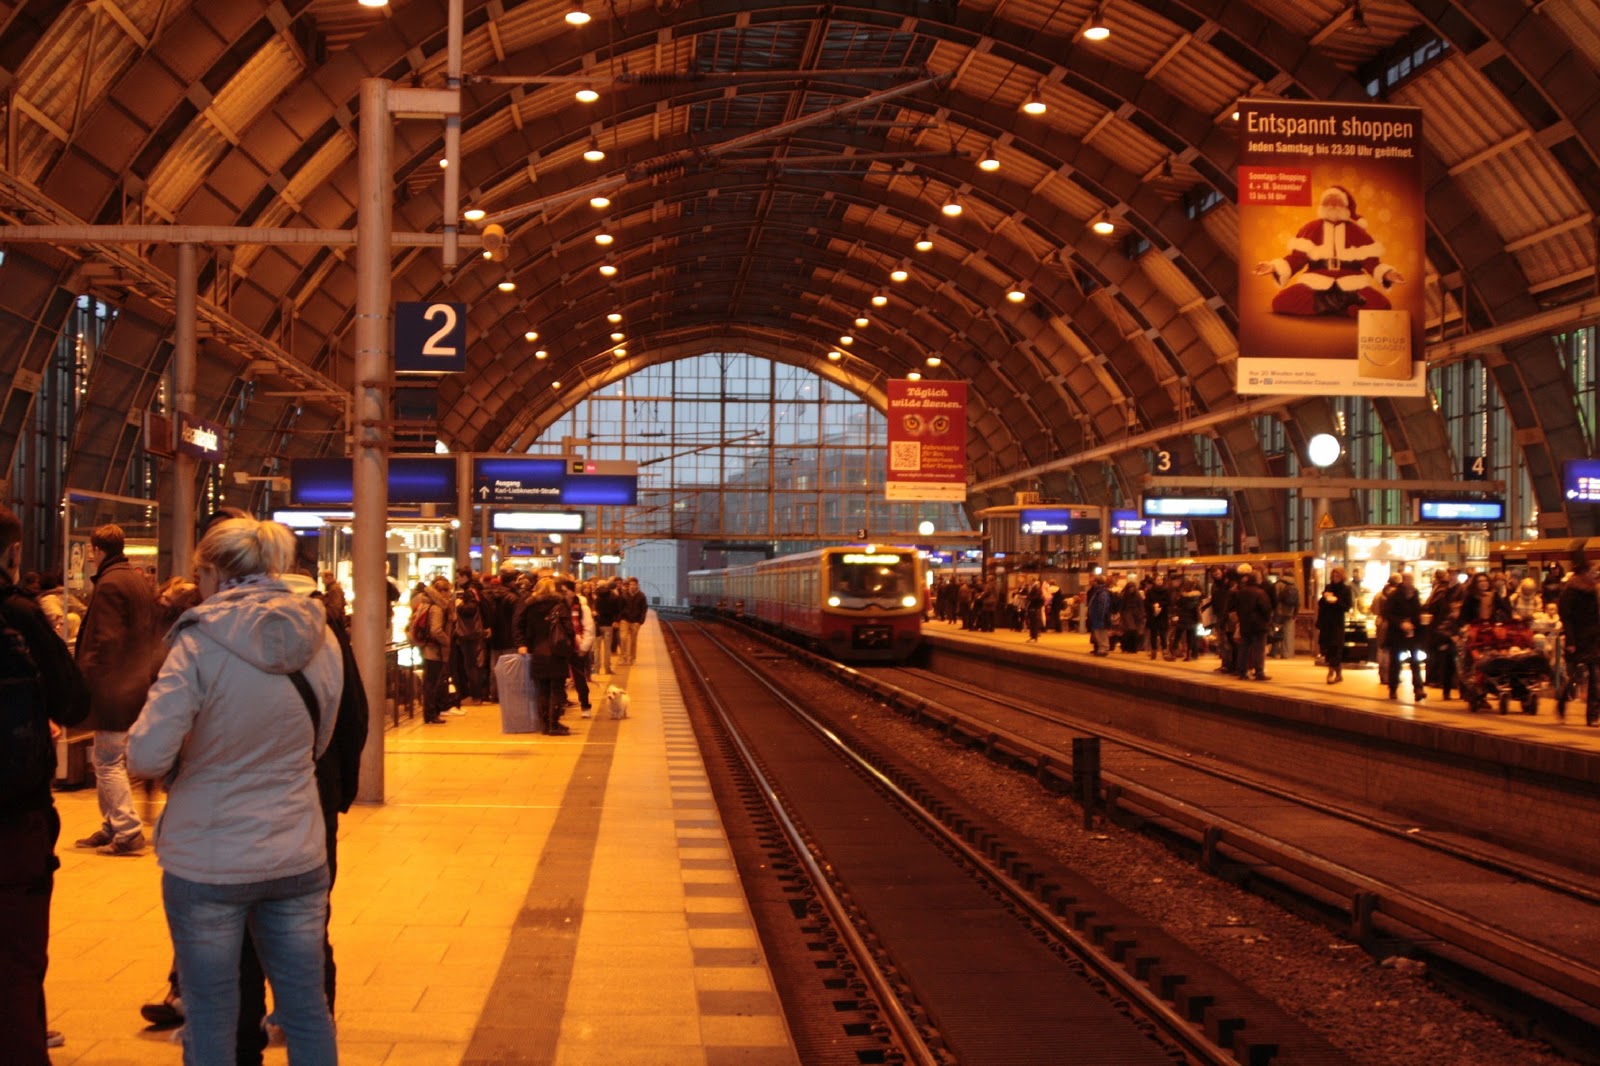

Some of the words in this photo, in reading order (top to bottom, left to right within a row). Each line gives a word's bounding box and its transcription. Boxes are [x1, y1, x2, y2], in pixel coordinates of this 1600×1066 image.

[1248, 111, 1337, 137] Entspannt
[1342, 116, 1413, 141] shoppen
[1248, 141, 1274, 152] Jeden
[1276, 142, 1314, 156] Samstag
[1316, 143, 1329, 154] bis
[1357, 144, 1373, 156] Uhr
[422, 303, 457, 356] 2
[1360, 336, 1407, 344] GROPIUS
[907, 387, 949, 399] Täglich
[891, 398, 921, 408] wilde
[1157, 451, 1172, 471] 3
[1471, 457, 1485, 476] 4
[495, 479, 521, 488] Ausgang
[858, 528, 865, 538] 3
